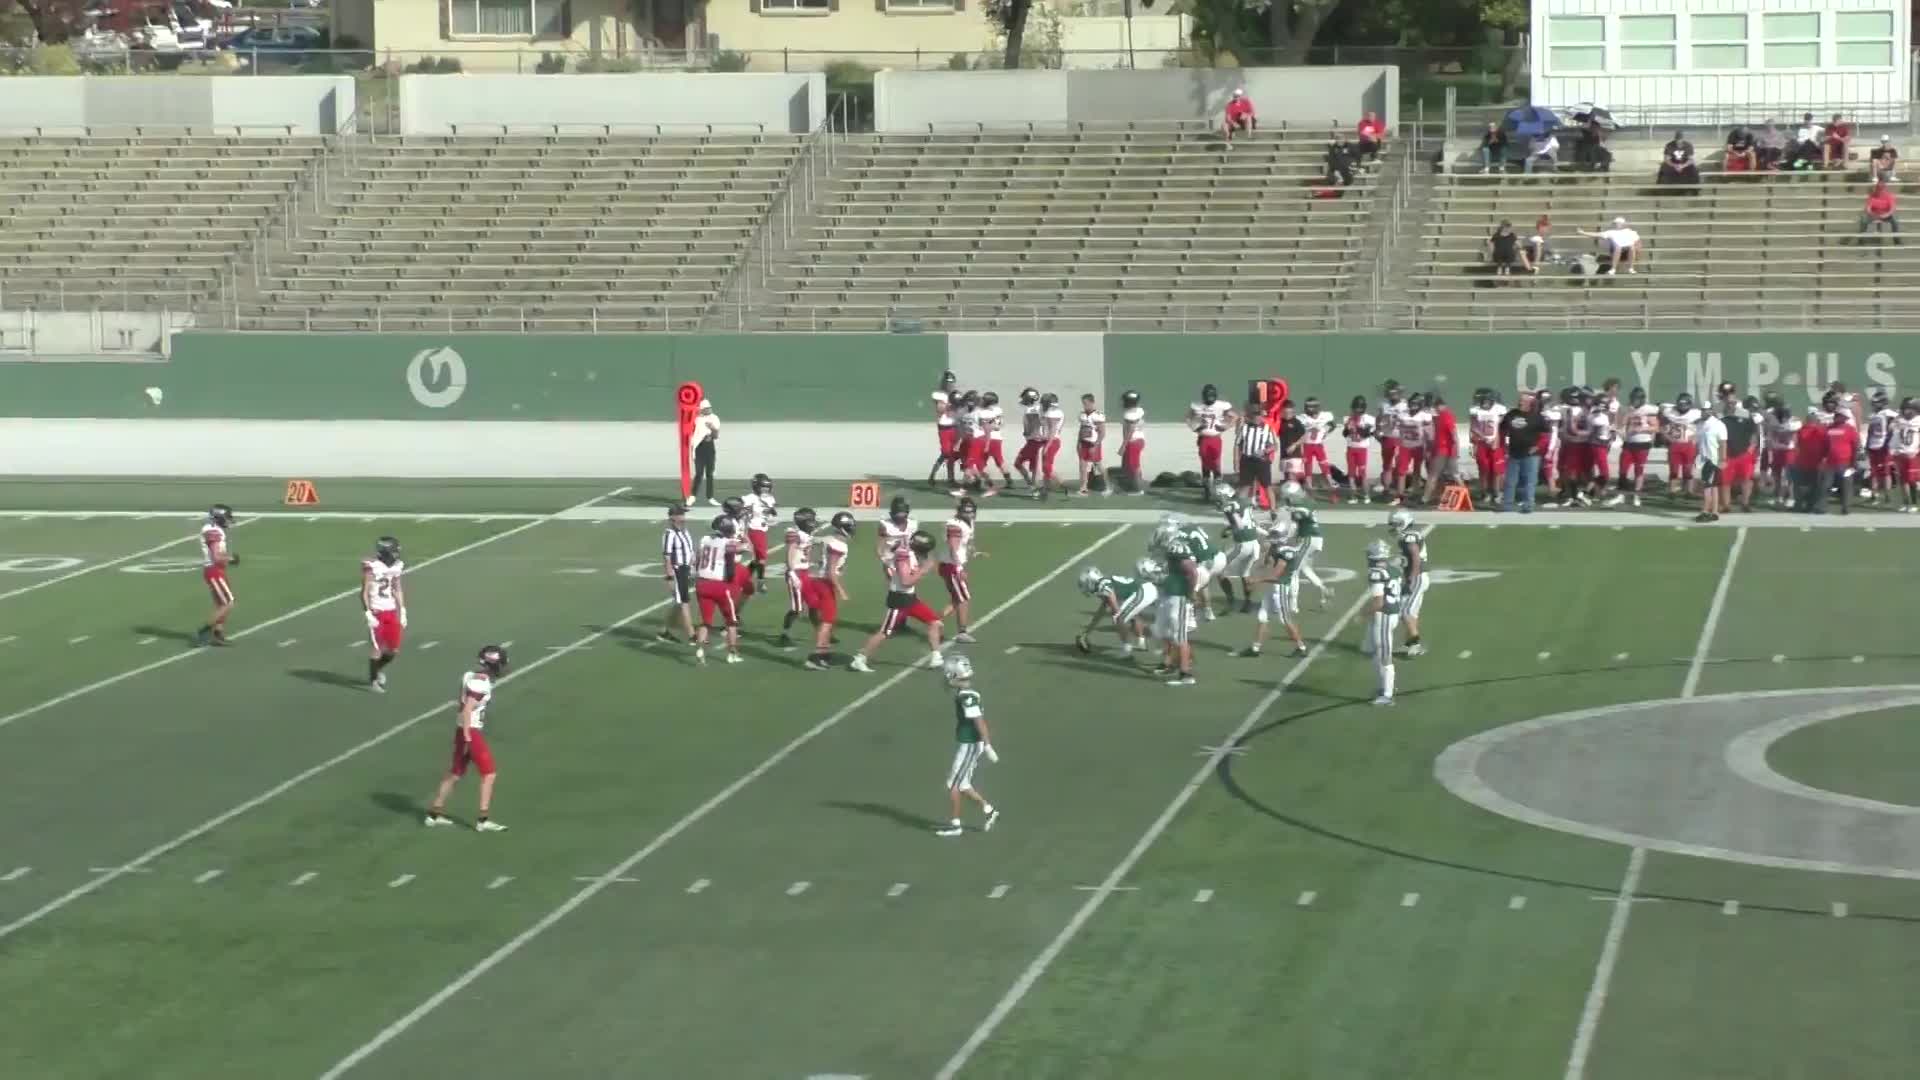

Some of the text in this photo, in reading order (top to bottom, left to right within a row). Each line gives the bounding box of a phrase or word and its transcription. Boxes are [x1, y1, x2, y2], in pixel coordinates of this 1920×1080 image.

[288, 482, 306, 502] 20
[853, 485, 875, 506] 30
[700, 545, 719, 571] 81
